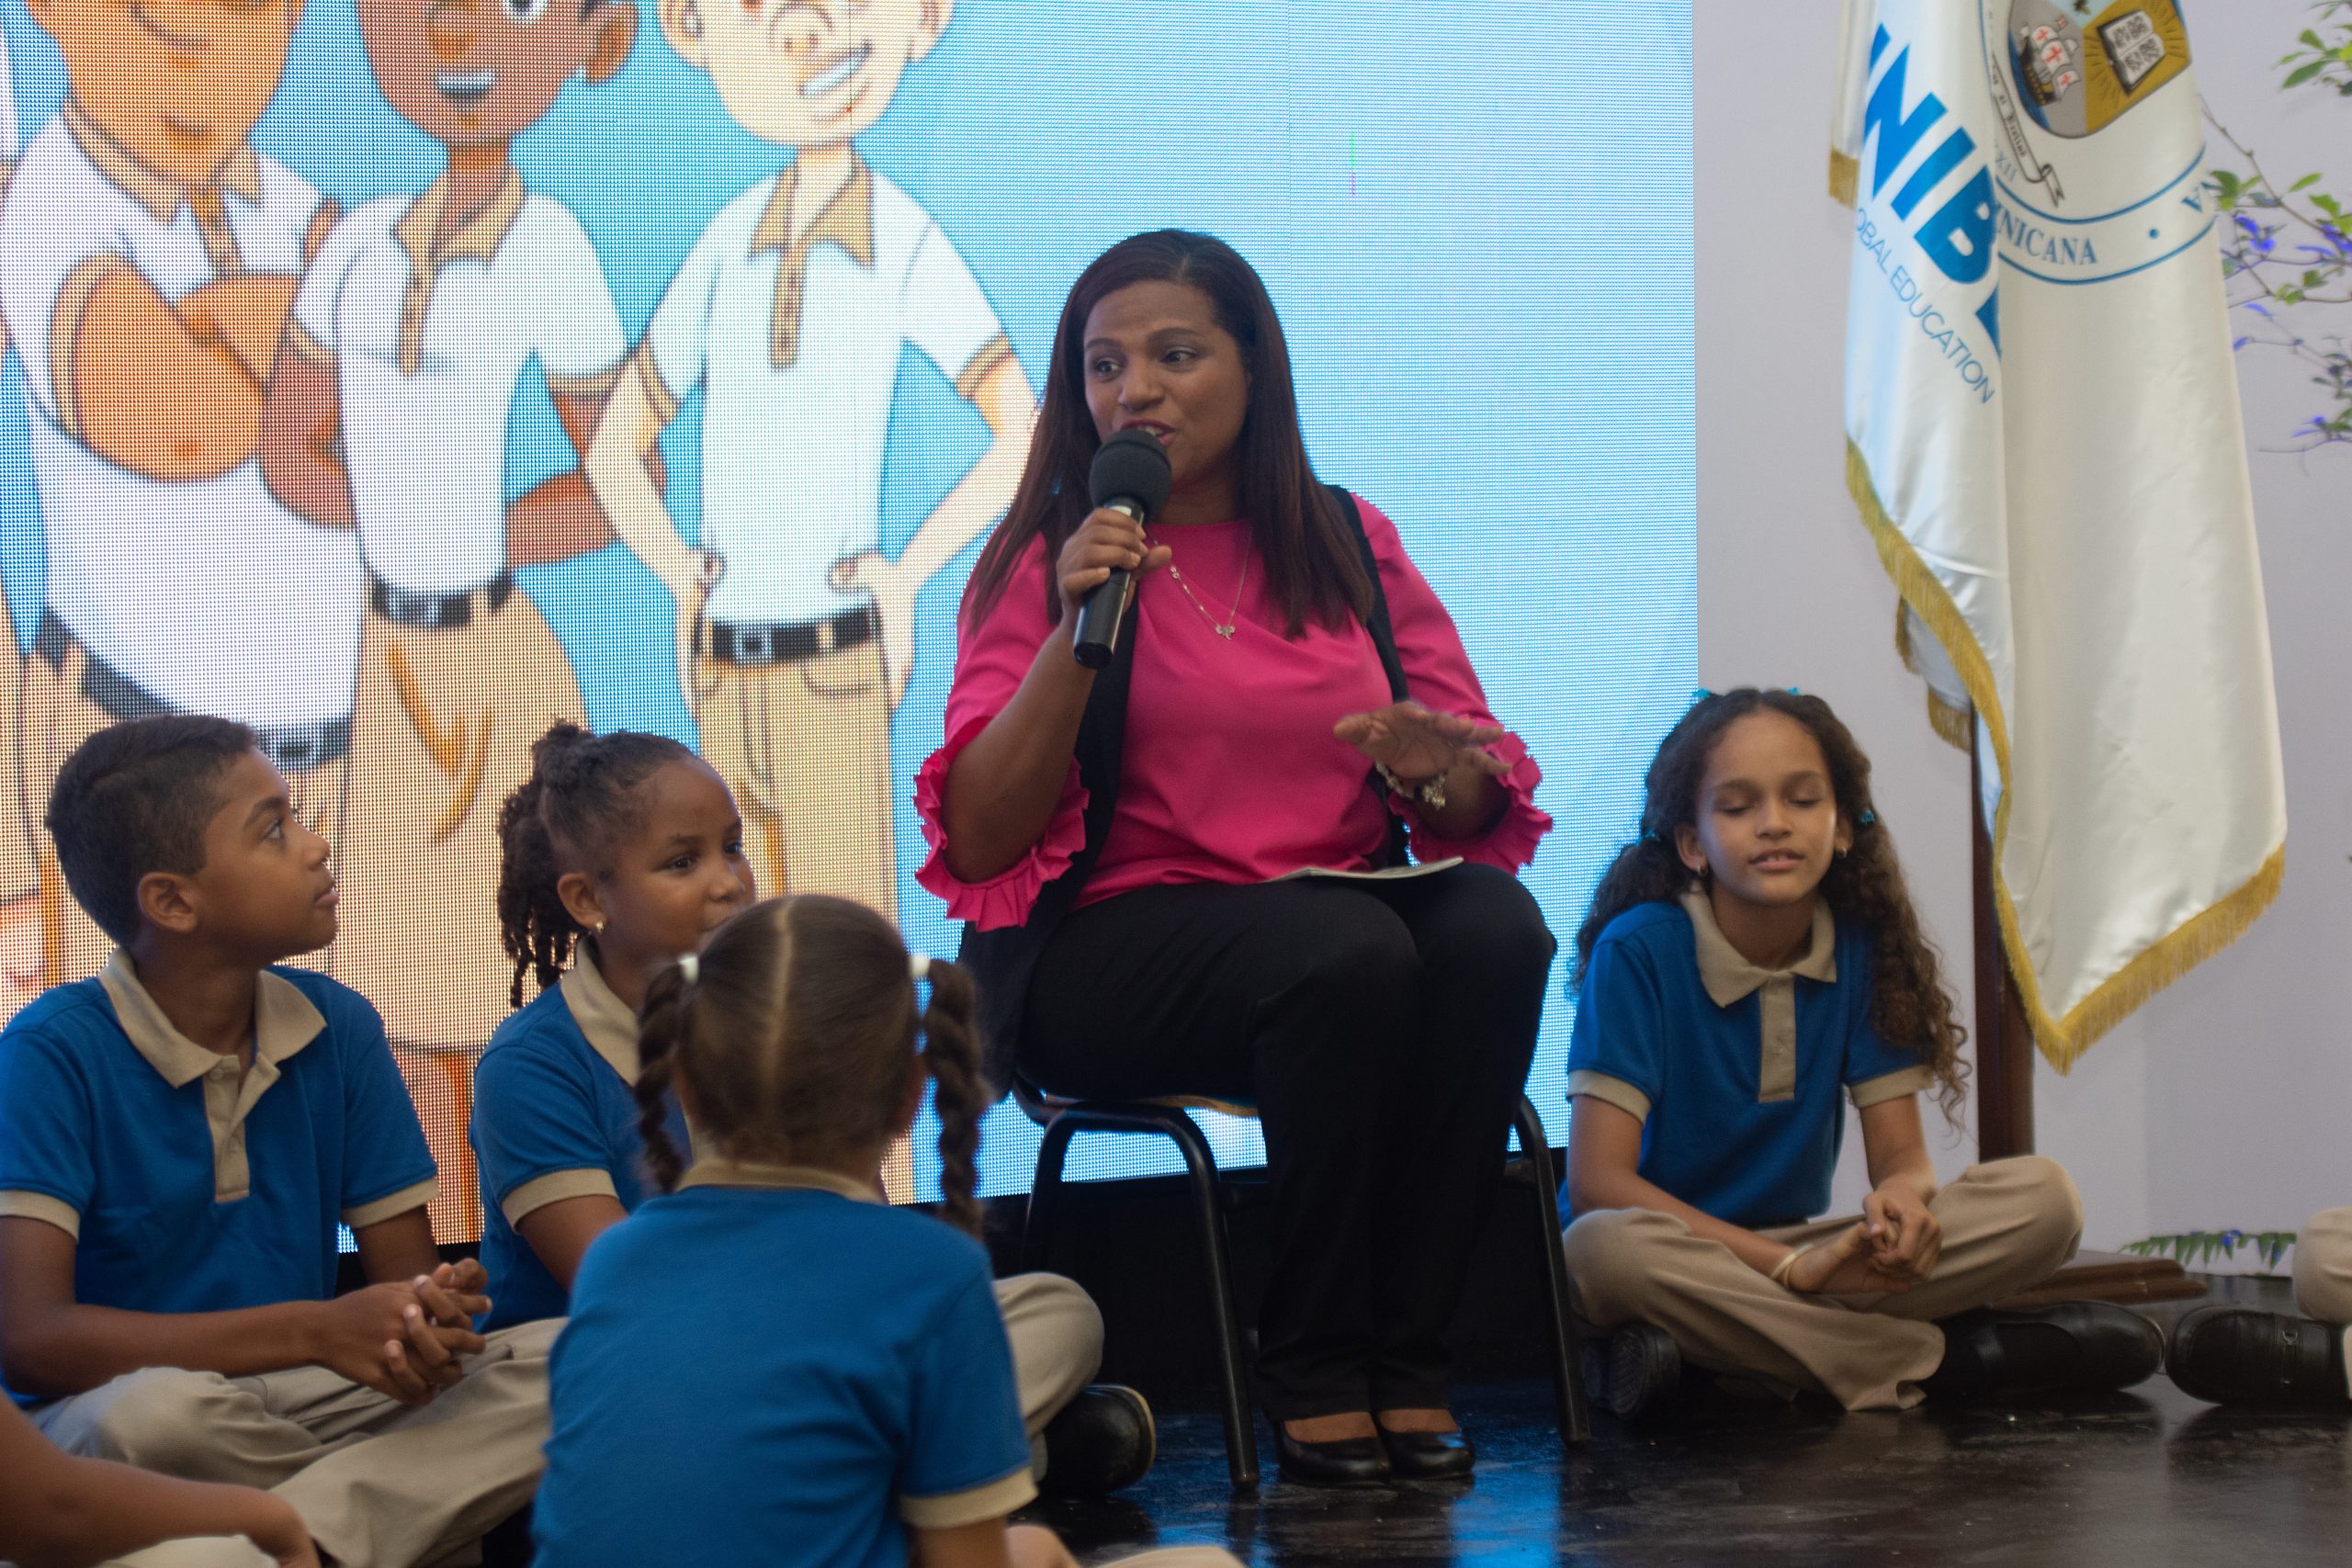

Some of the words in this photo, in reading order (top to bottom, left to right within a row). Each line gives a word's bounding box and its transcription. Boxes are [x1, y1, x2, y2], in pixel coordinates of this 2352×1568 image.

[1863, 22, 2002, 366] NIB
[1996, 202, 2098, 265] NICANA
[1890, 265, 1996, 404] EDUCATION
